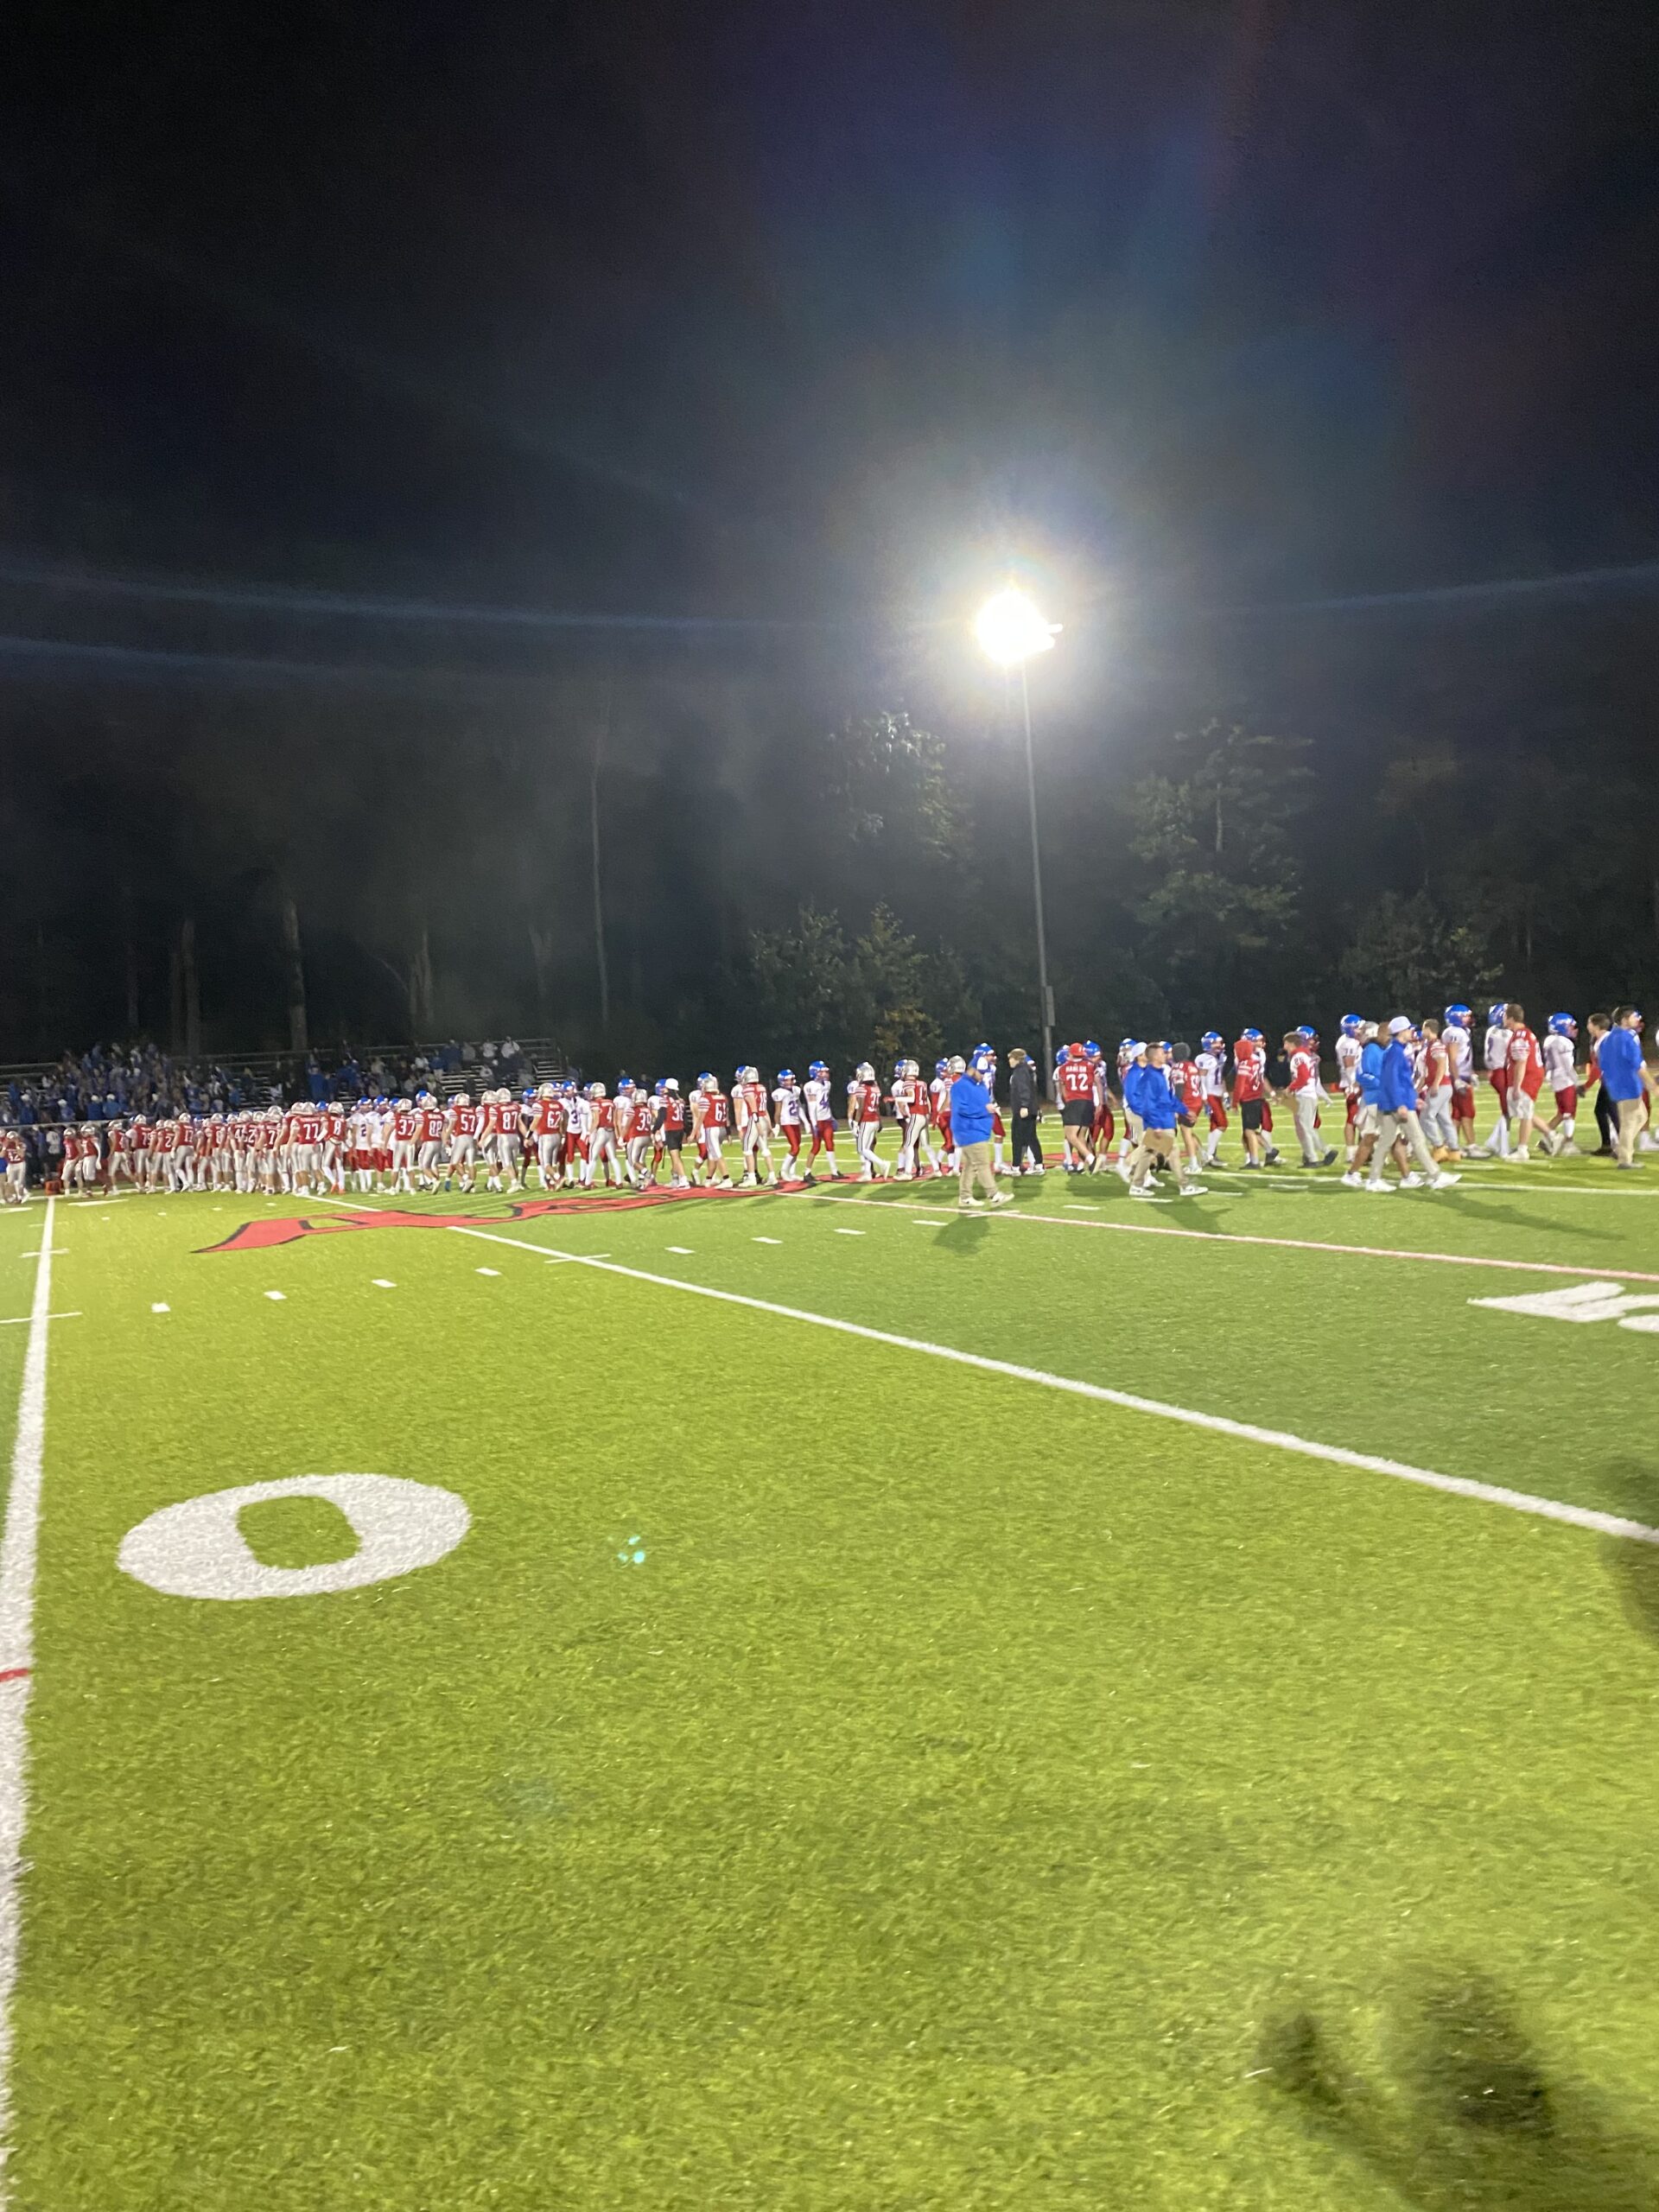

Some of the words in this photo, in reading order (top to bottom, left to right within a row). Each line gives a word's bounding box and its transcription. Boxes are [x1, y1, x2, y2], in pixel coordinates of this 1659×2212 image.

[1065, 1073, 1089, 1091] 72
[334, 1120, 342, 1136] 8
[397, 1119, 415, 1136] 37
[461, 1113, 476, 1132] 57
[502, 1110, 518, 1130] 87
[302, 1123, 319, 1140] 77
[115, 1472, 472, 1601] 0
